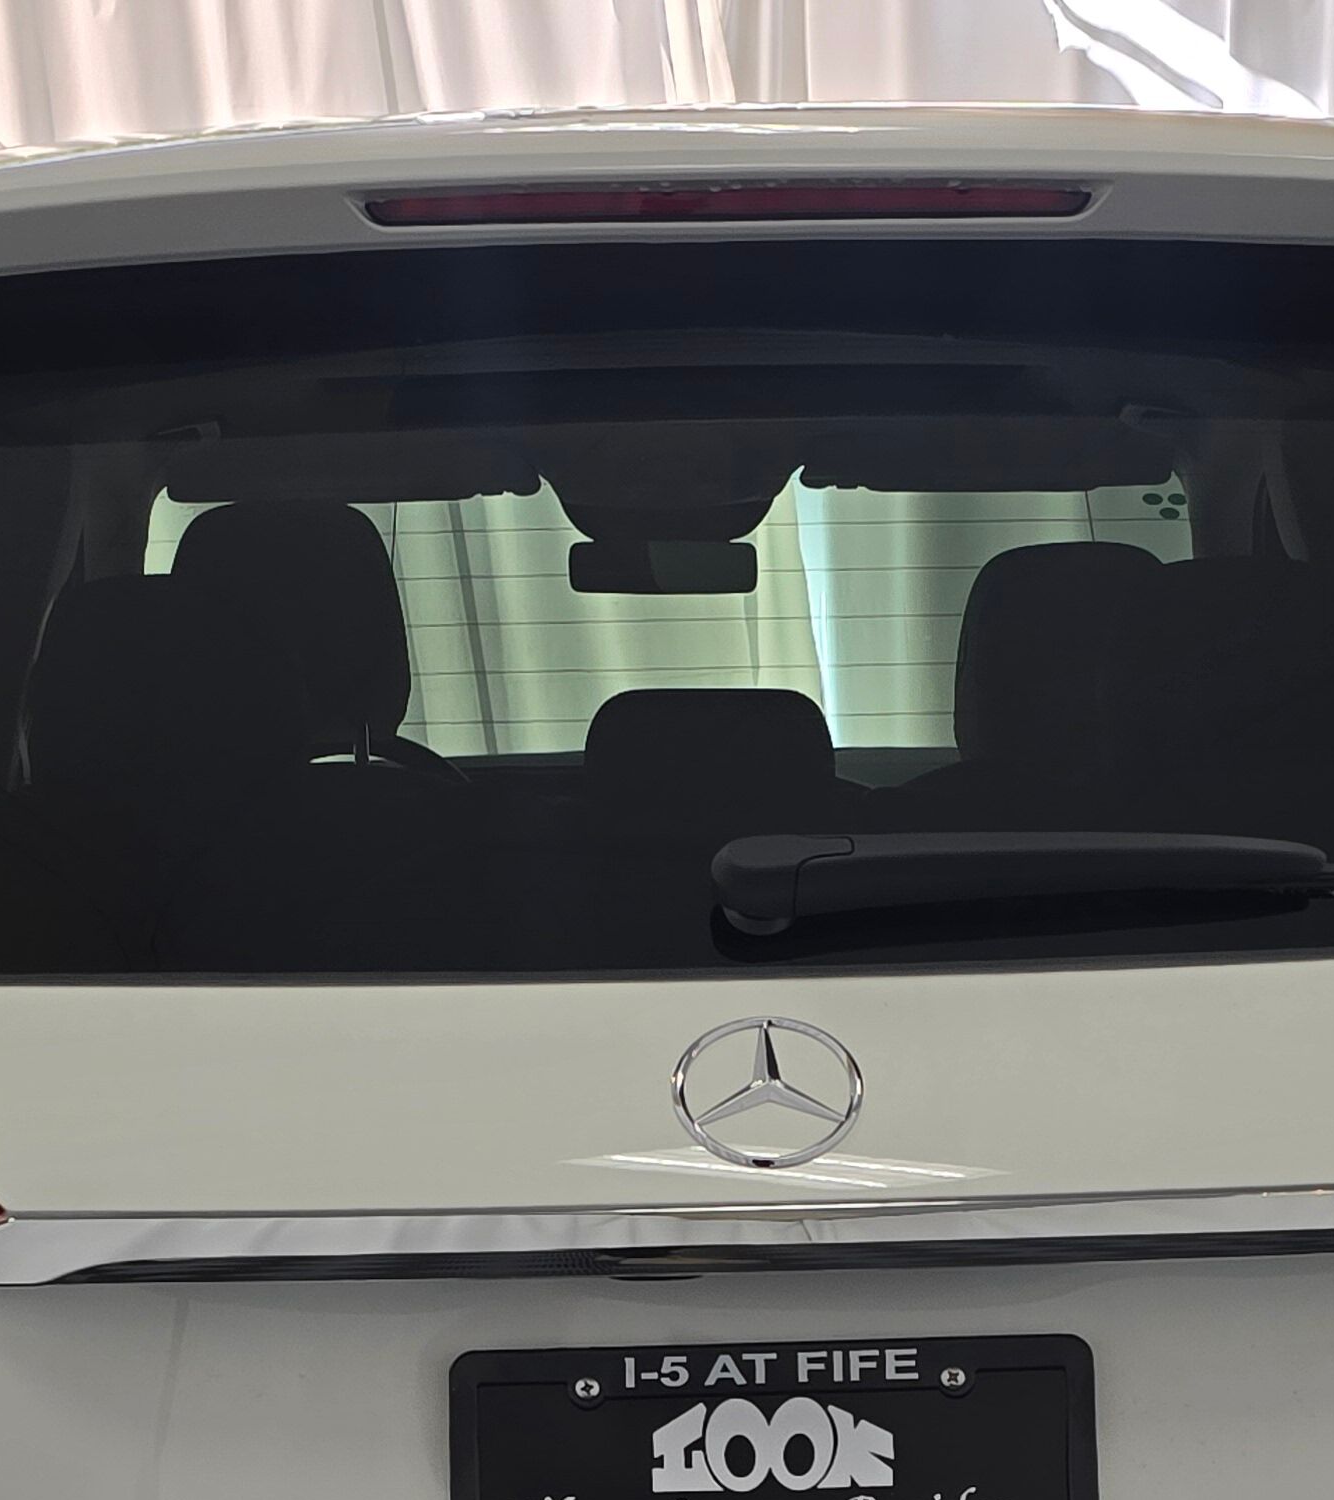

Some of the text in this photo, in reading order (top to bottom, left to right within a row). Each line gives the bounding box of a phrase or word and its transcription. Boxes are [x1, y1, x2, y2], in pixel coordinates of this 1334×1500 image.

[624, 1348, 920, 1389] I-5 AT FIFE
